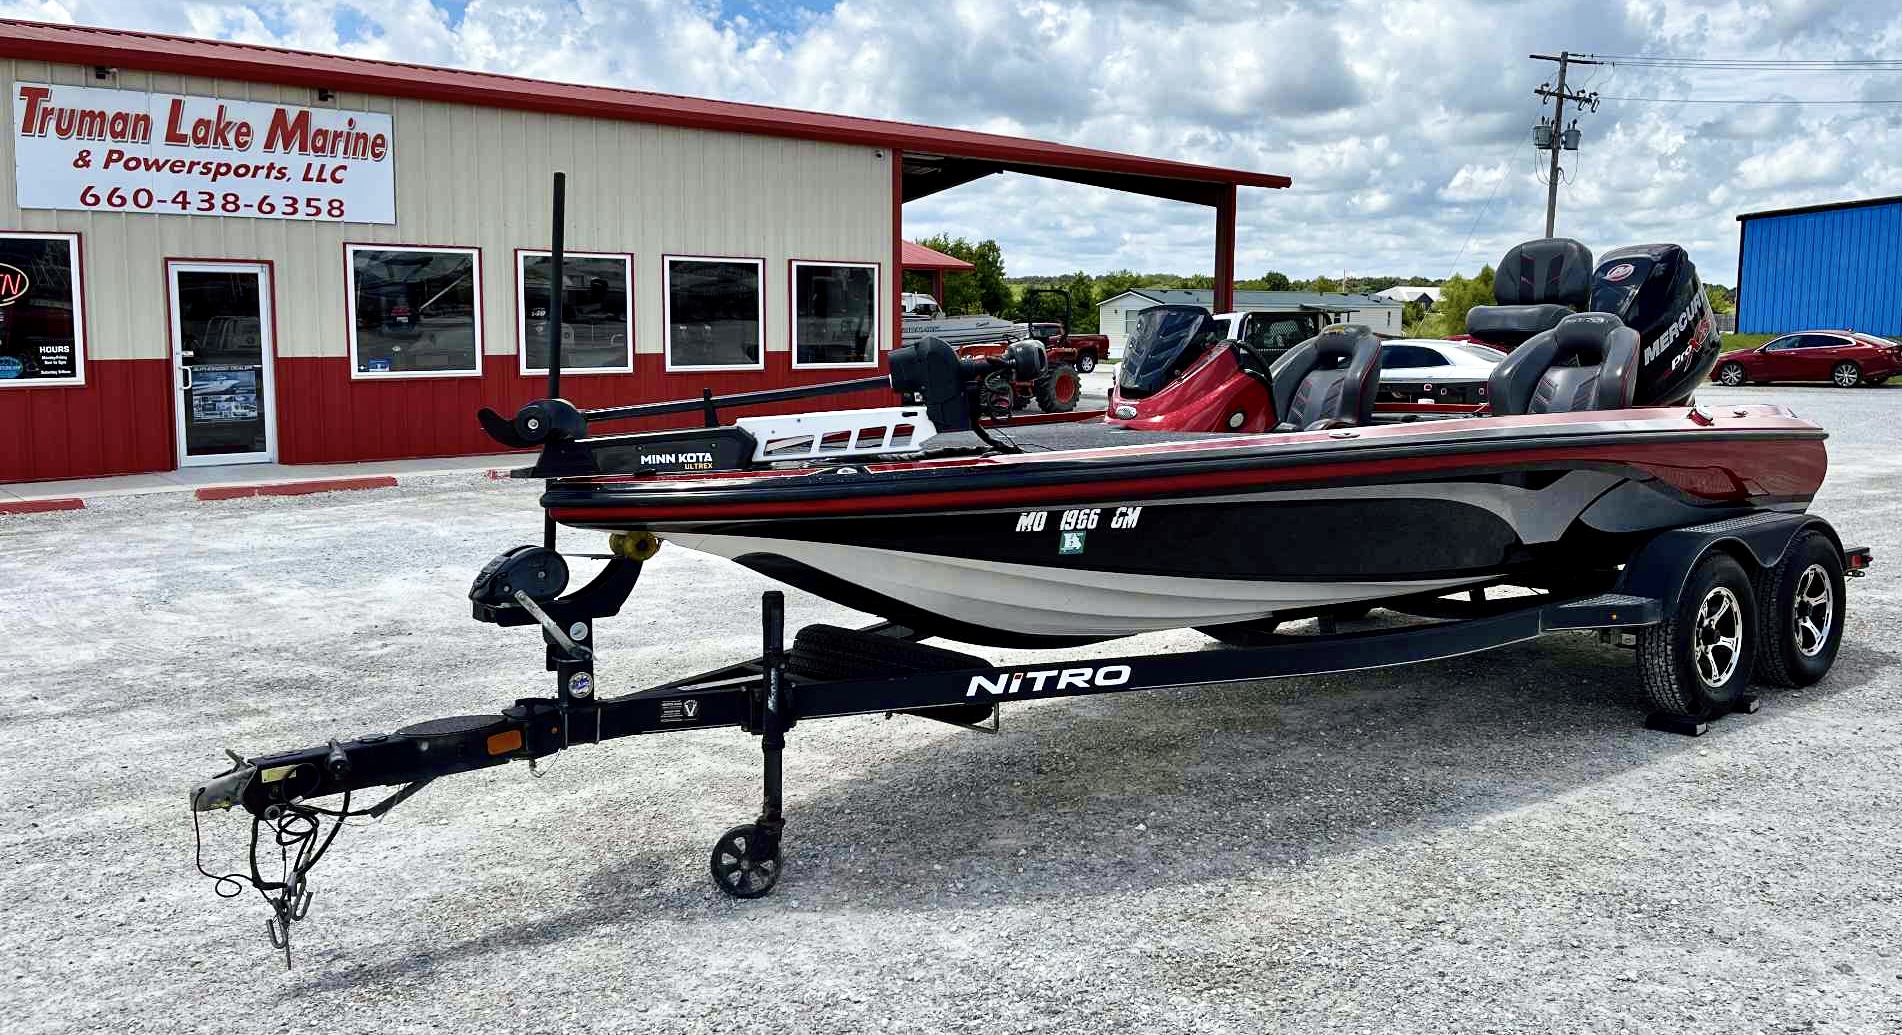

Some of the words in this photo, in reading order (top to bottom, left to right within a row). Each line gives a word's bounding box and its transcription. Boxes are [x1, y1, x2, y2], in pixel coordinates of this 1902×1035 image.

[19, 86, 153, 144] Truman
[164, 98, 254, 152] Lake
[263, 107, 388, 162] Marine
[73, 149, 92, 169] &
[103, 149, 292, 182] Powersports,
[302, 162, 348, 185] LLC
[79, 186, 345, 218] 660-438-6358
[39, 345, 70, 353] HOURS
[640, 453, 676, 465] MINN
[678, 452, 713, 463] KOTA
[684, 462, 713, 470] ULTREX
[1015, 511, 1048, 532] MO
[1059, 508, 1101, 531] 1966
